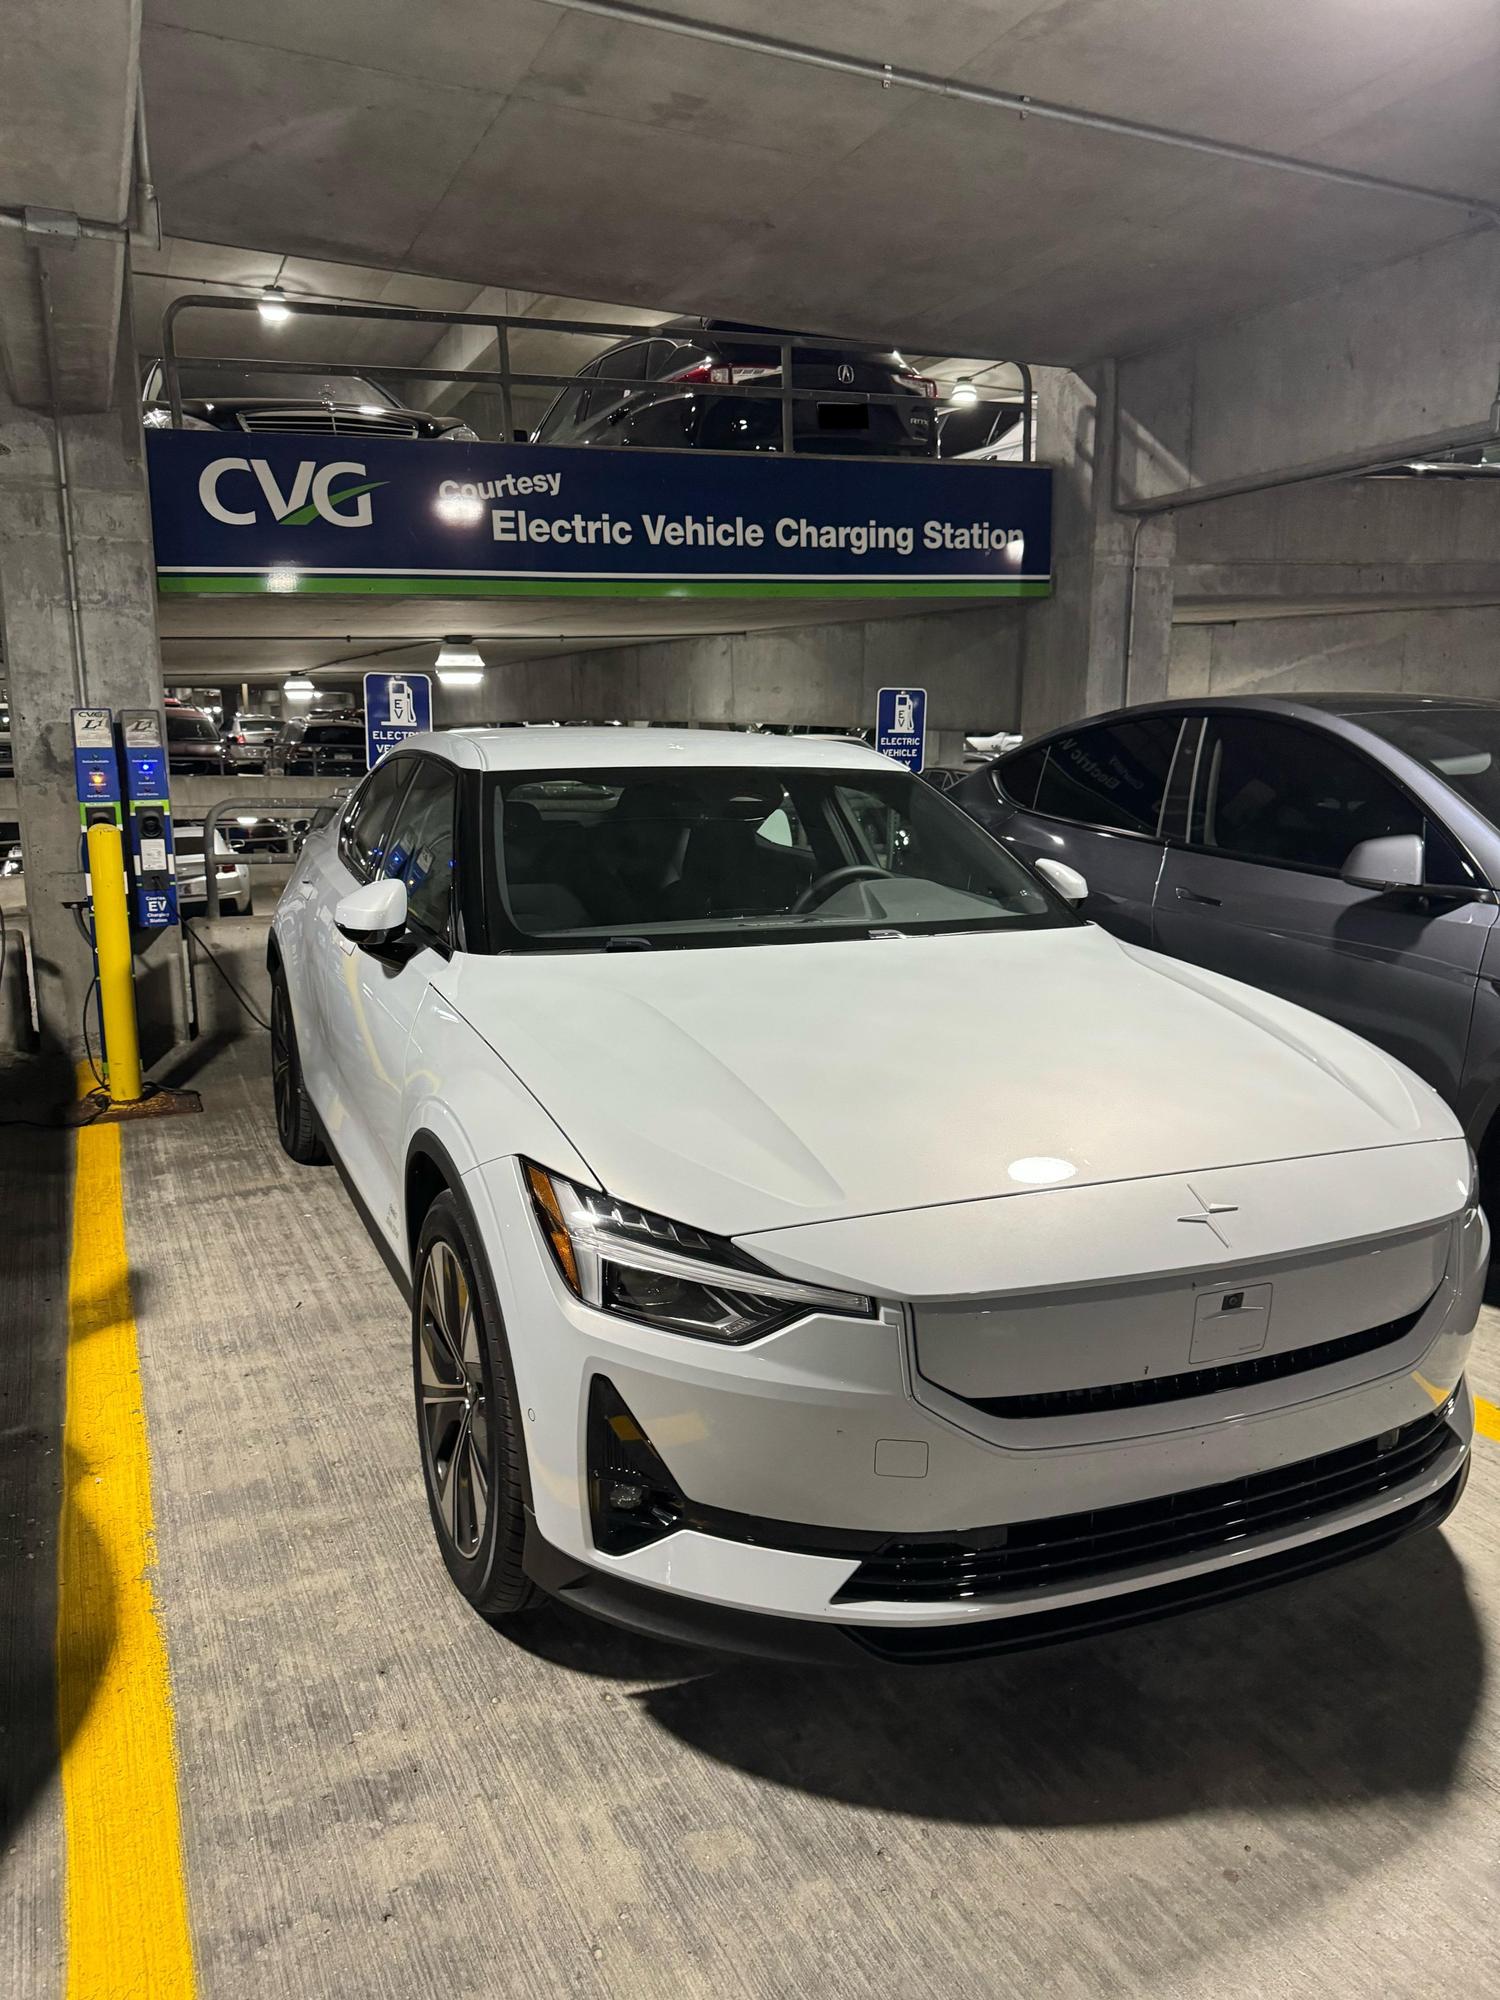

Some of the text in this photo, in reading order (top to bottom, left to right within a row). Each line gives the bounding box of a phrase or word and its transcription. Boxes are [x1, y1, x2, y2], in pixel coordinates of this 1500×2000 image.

[199, 457, 373, 527] CVG
[438, 472, 561, 501] Courtesy
[491, 509, 1024, 555] Electric Vehicle Charging Station
[880, 737, 920, 746] ELECTRIC
[882, 749, 917, 757] VEHICLE
[148, 901, 167, 912] EV
